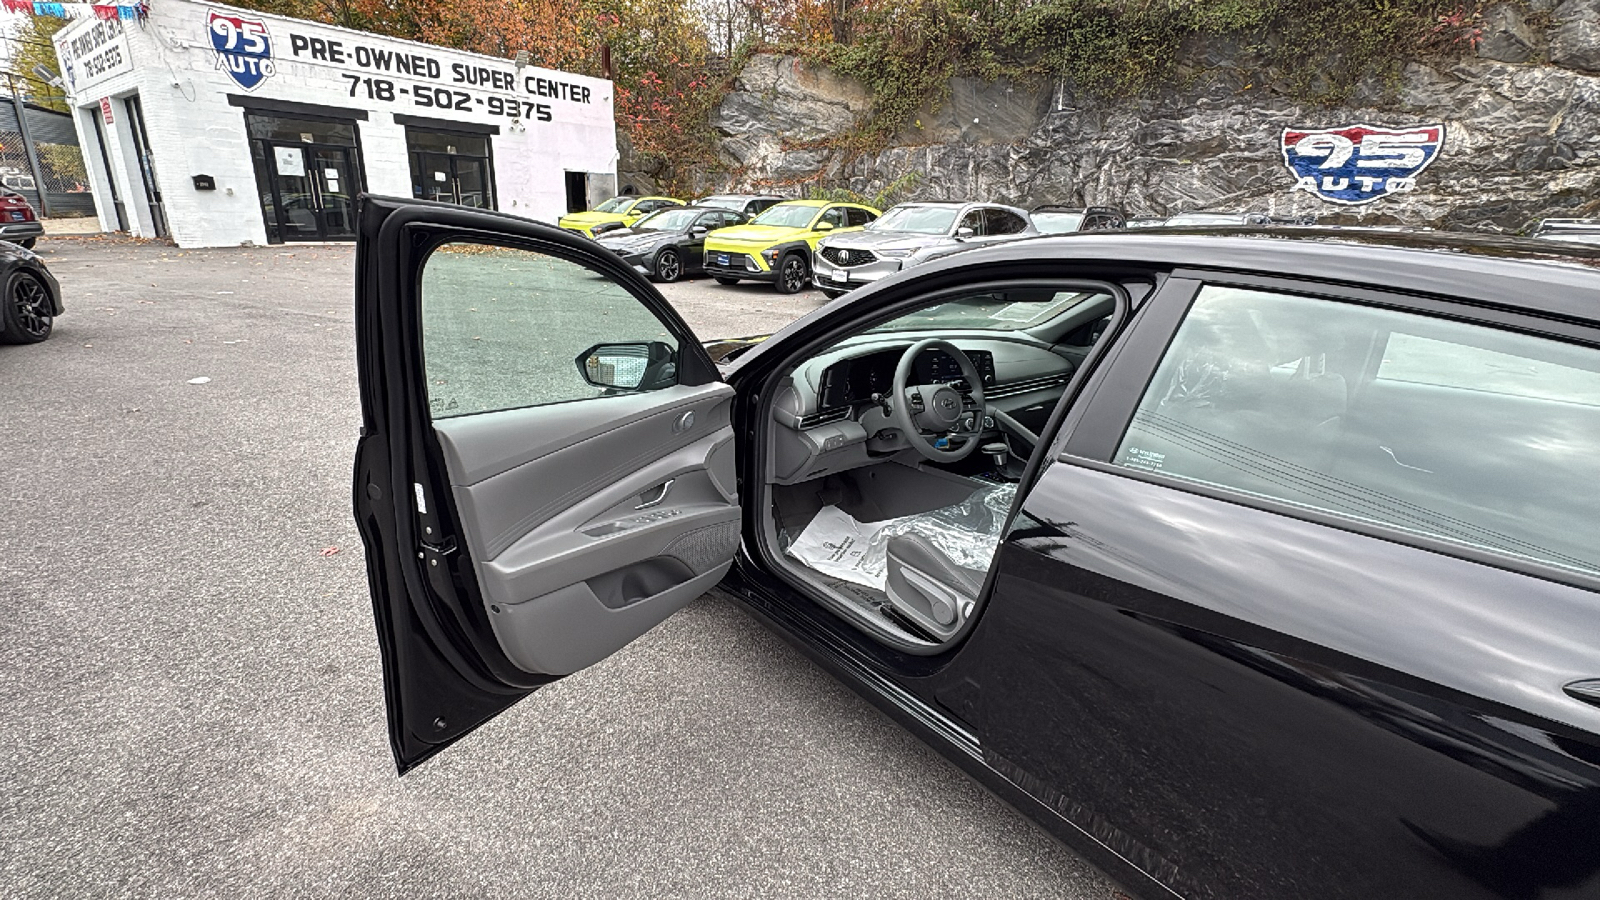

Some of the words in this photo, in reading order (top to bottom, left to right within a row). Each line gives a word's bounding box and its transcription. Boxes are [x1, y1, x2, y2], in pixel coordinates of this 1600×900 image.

[212, 18, 266, 53] 95
[215, 52, 276, 77] AUTO
[290, 33, 441, 79] PRE-OWNED
[452, 63, 516, 92] SUPER
[524, 76, 591, 104] CENTER
[341, 73, 552, 122] 718-502-9375
[1295, 132, 1429, 169] 95
[1290, 175, 1416, 193] AUTO
